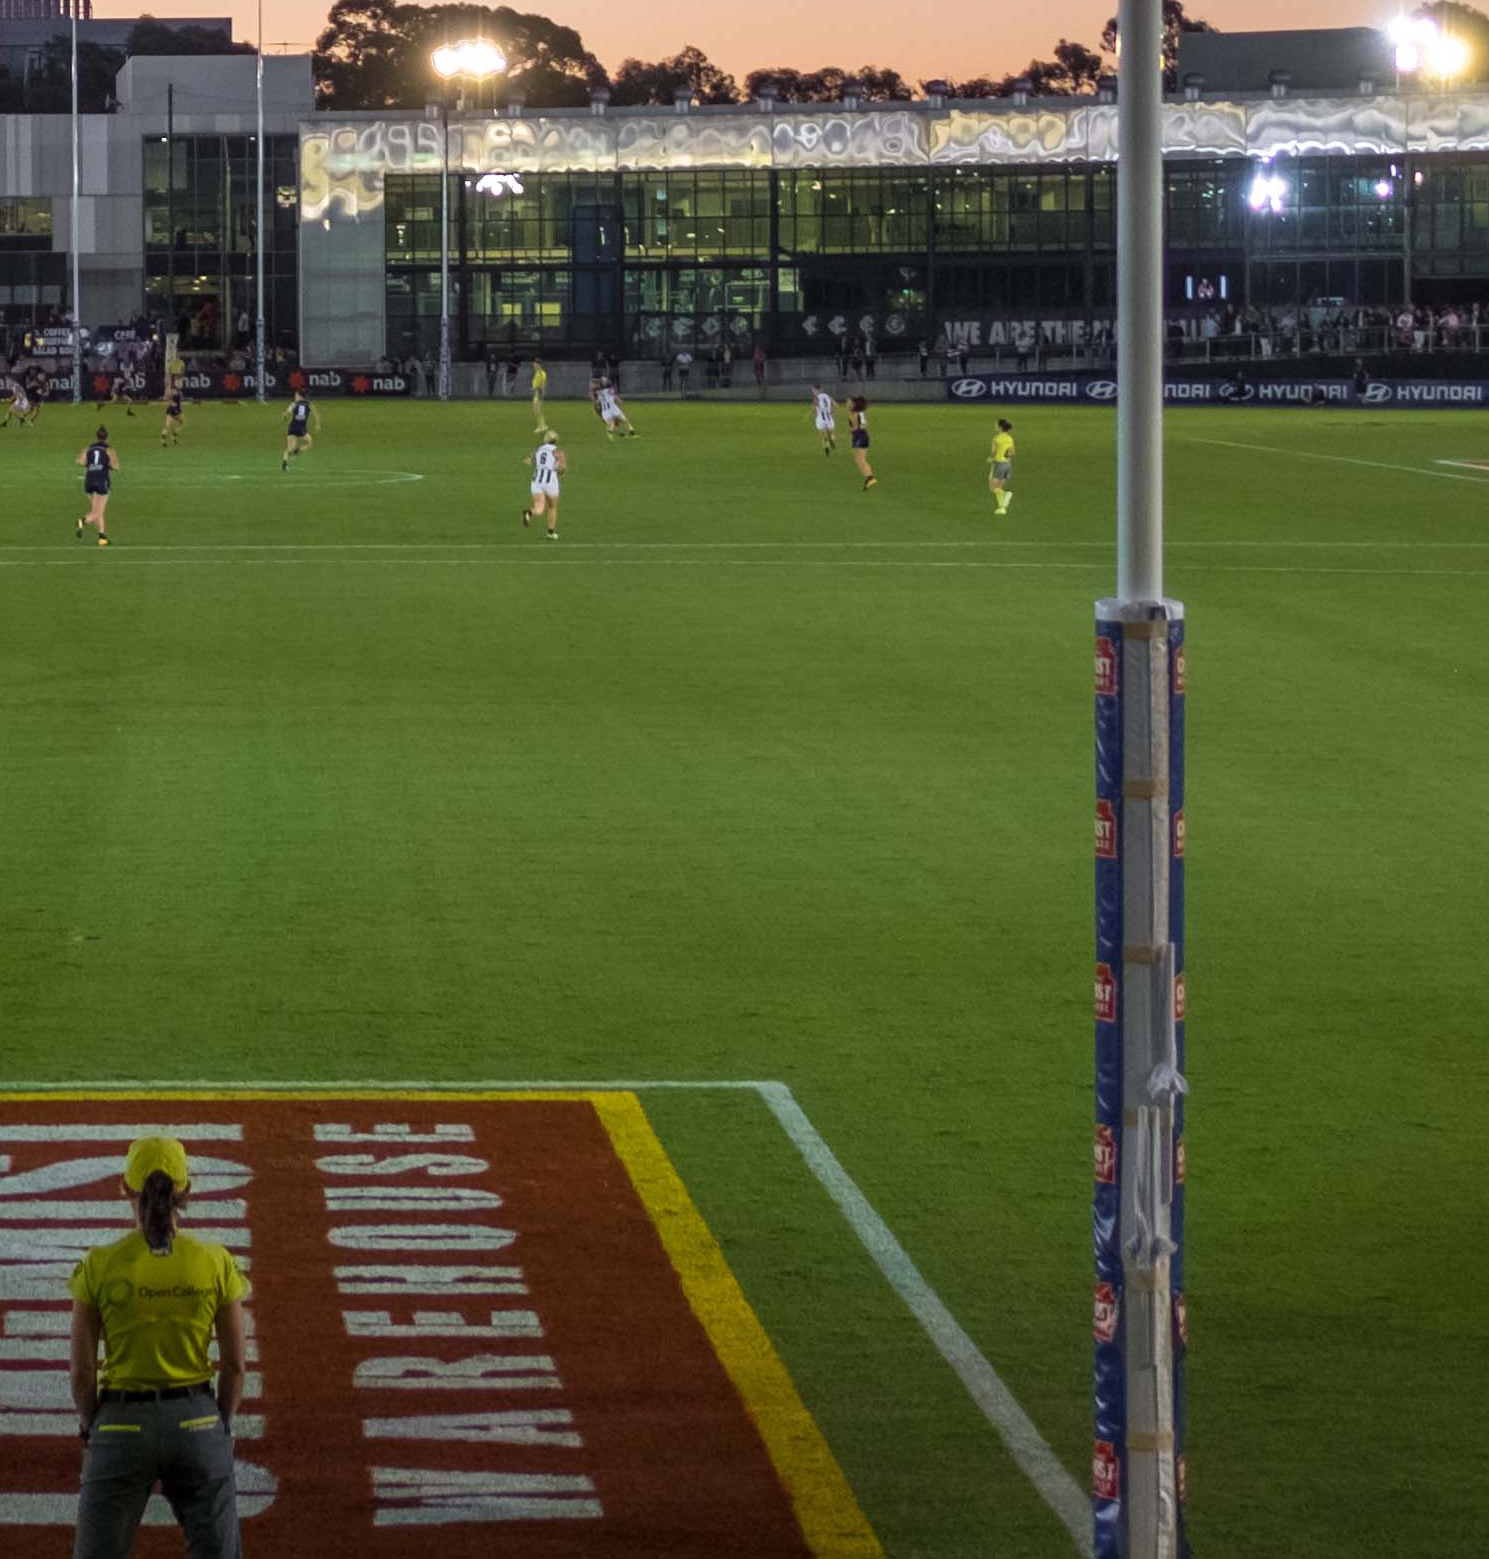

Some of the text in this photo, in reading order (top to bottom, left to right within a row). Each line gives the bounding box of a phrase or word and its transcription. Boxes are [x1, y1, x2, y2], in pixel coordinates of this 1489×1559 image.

[944, 321, 980, 344] WE
[308, 371, 341, 388] nab
[372, 375, 405, 391] nab
[991, 381, 1077, 396] HYUNDAI
[1397, 385, 1482, 399] HYUNDAI
[93, 450, 100, 465] 1
[540, 452, 548, 464] 6
[312, 1123, 603, 1525] WAREHOUSE
